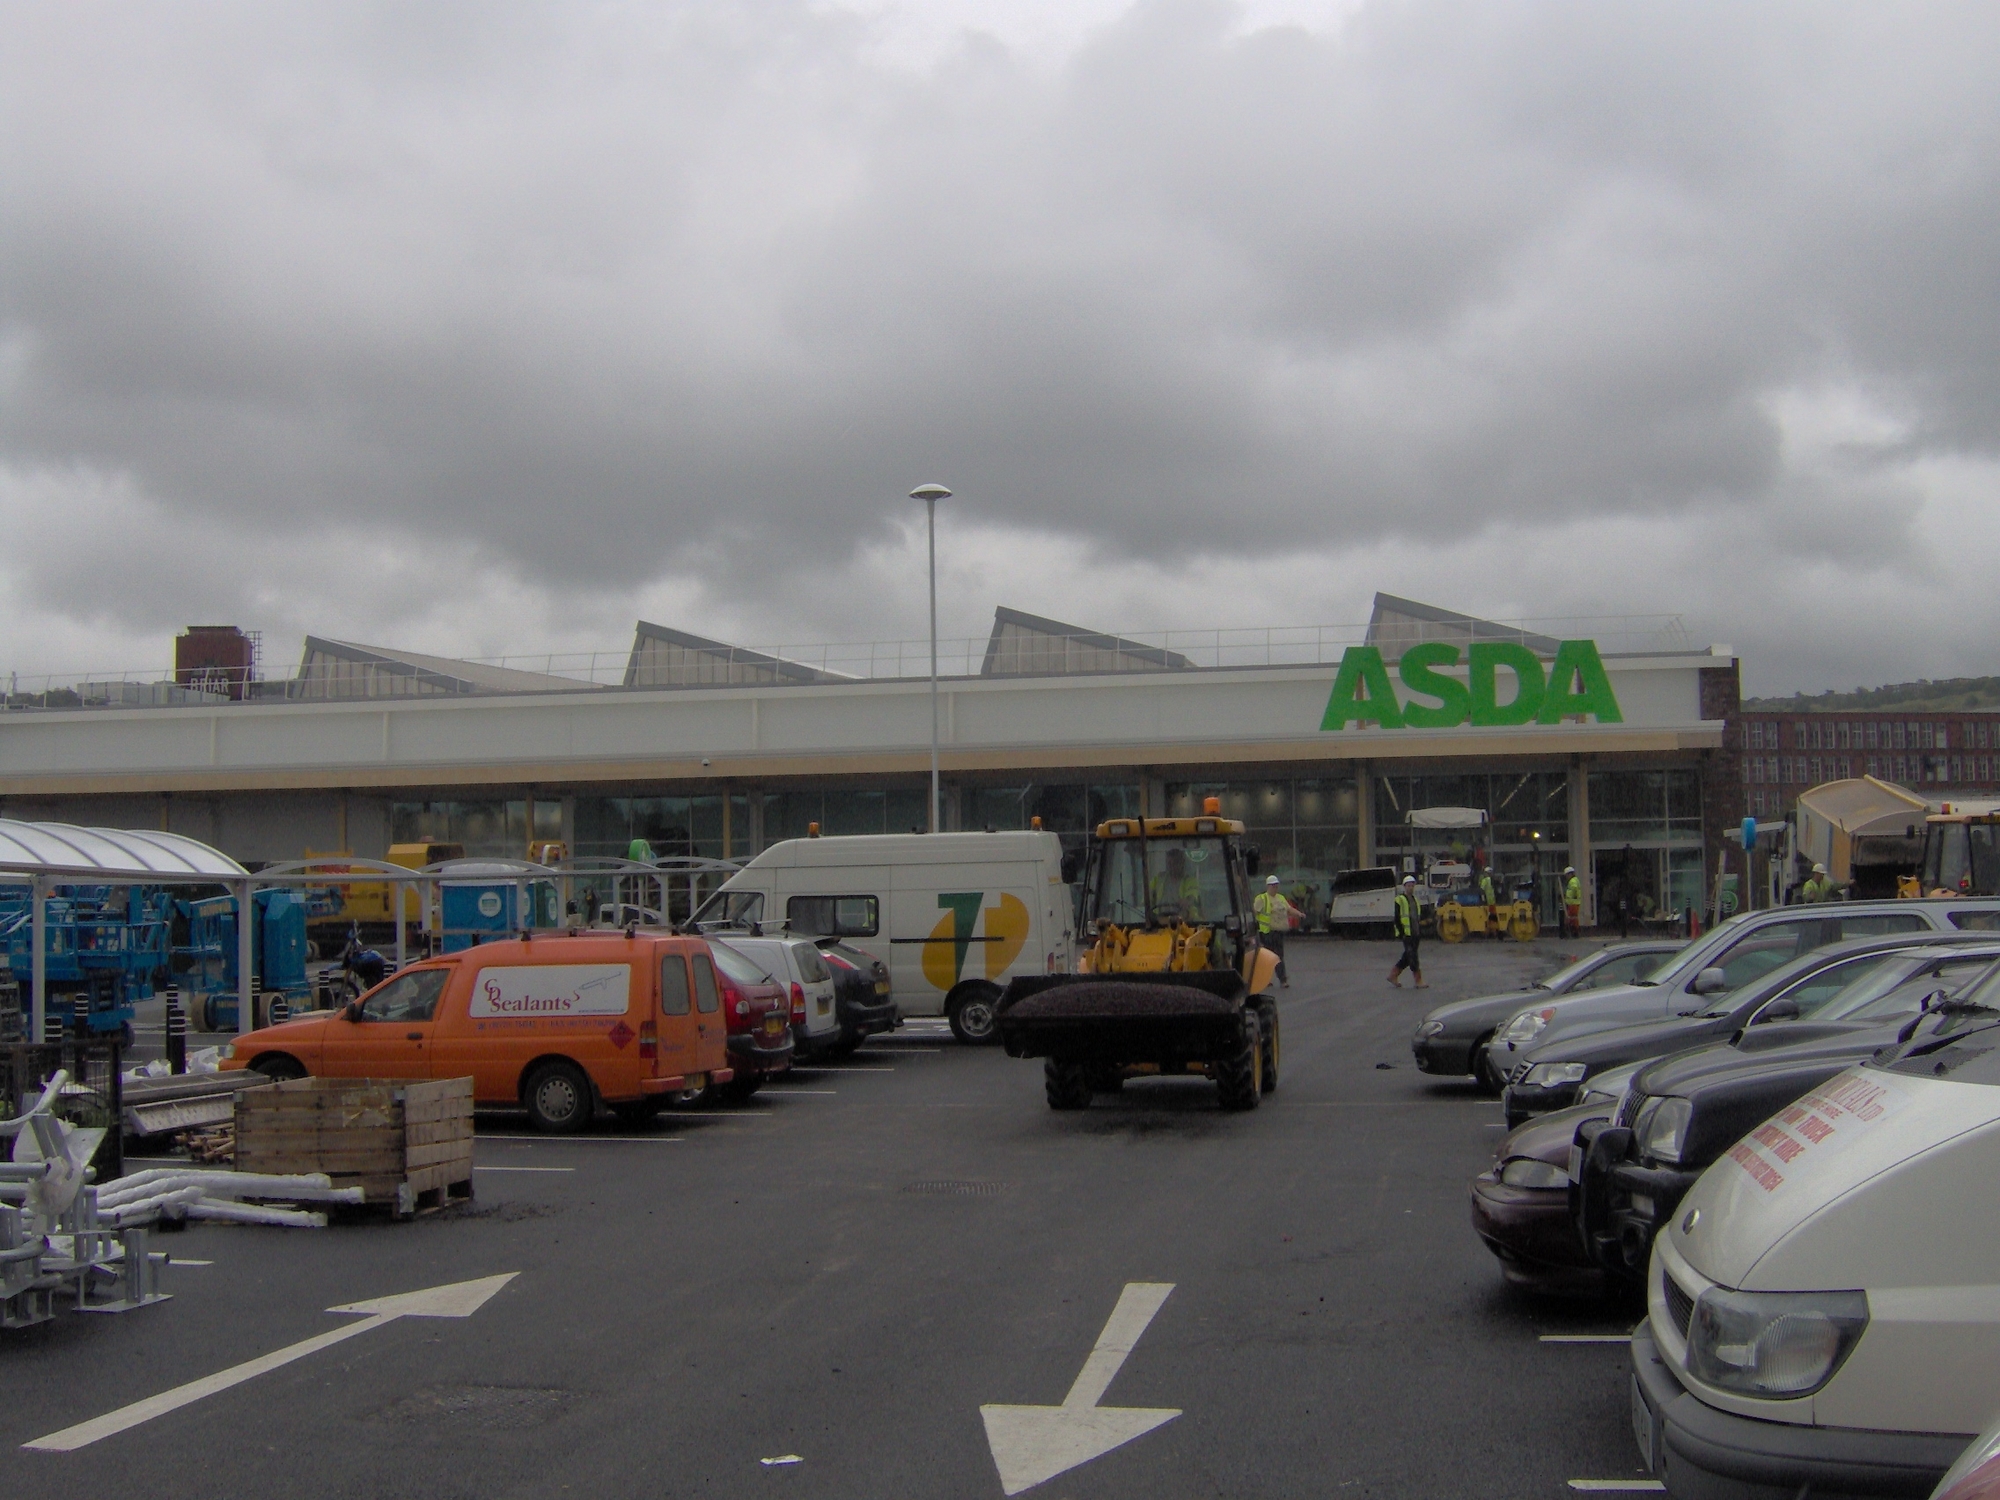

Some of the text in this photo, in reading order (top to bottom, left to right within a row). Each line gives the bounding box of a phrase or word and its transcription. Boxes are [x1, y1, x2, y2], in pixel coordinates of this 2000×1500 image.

[1319, 640, 1624, 731] ASDA
[490, 995, 571, 1013] Sealants
[1795, 1115, 1835, 1144] TRUCK
[1773, 1138, 1805, 1163] HIRE
